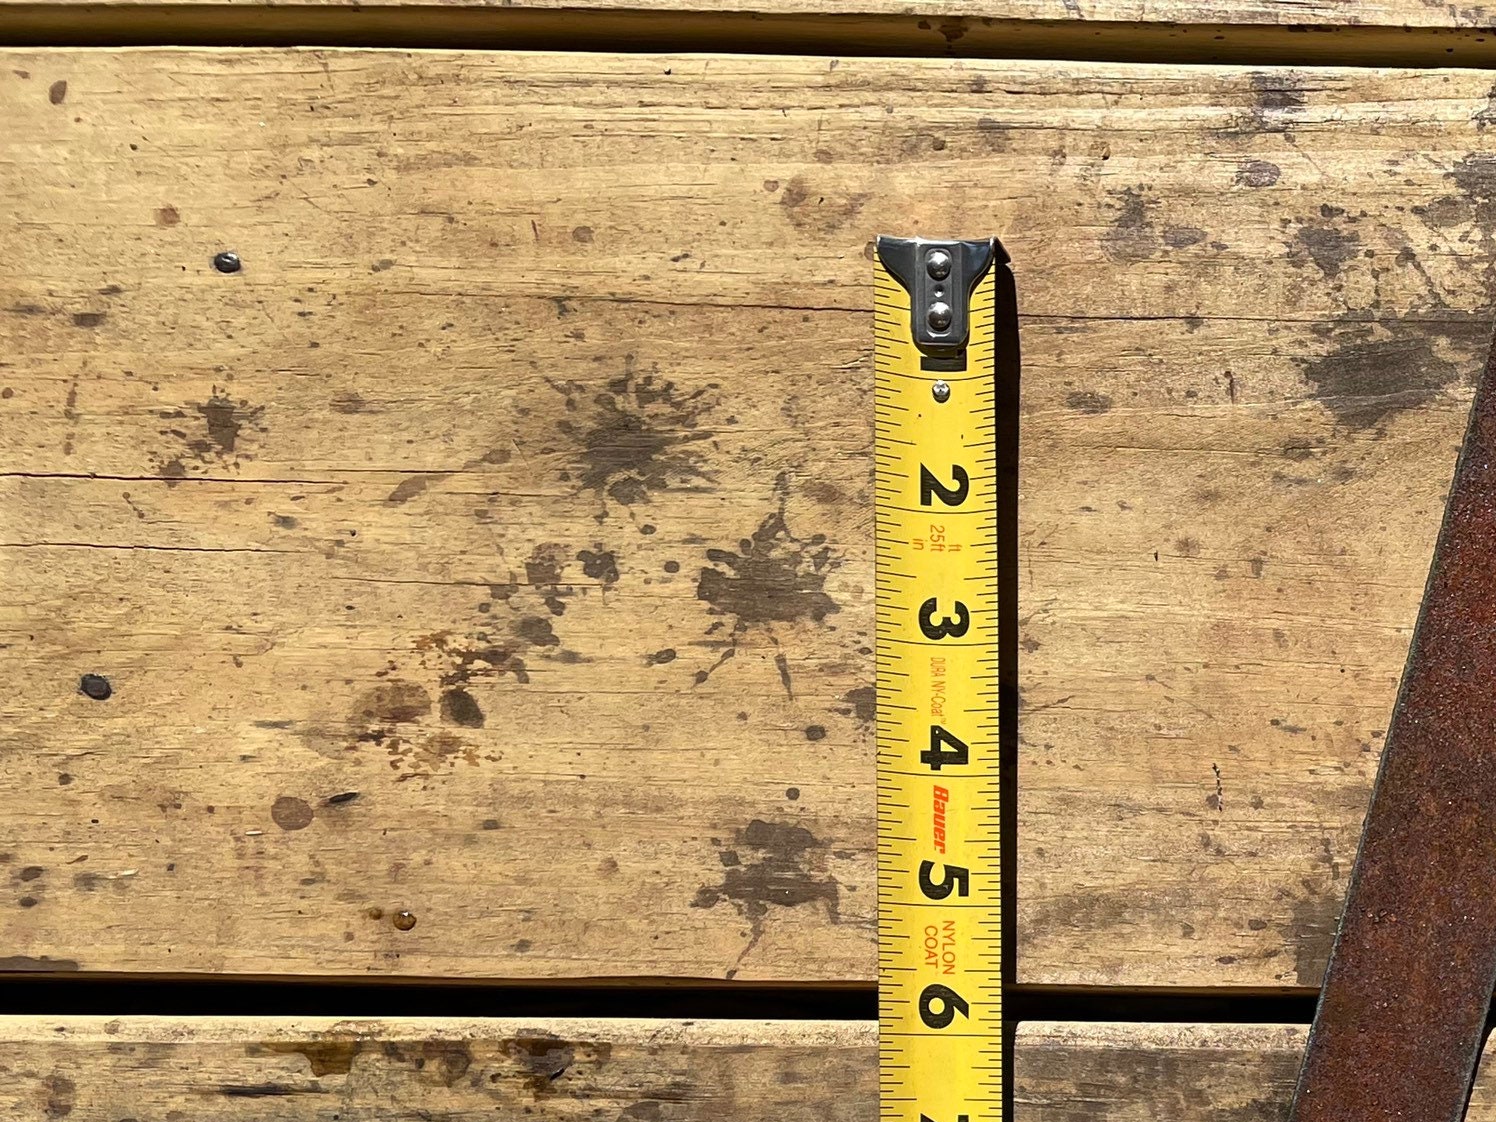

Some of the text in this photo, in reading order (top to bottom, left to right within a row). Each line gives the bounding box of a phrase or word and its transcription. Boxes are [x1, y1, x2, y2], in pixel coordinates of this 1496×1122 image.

[919, 463, 970, 507] 2
[912, 538, 928, 551] in
[929, 524, 945, 552] 25ft
[947, 543, 962, 553] ft
[918, 597, 970, 640] 3
[920, 725, 968, 771] 4
[933, 785, 949, 854] Bauer
[918, 860, 969, 900] 5
[924, 925, 938, 969] COAT
[942, 920, 956, 975] NYLON
[919, 983, 970, 1029] 6
